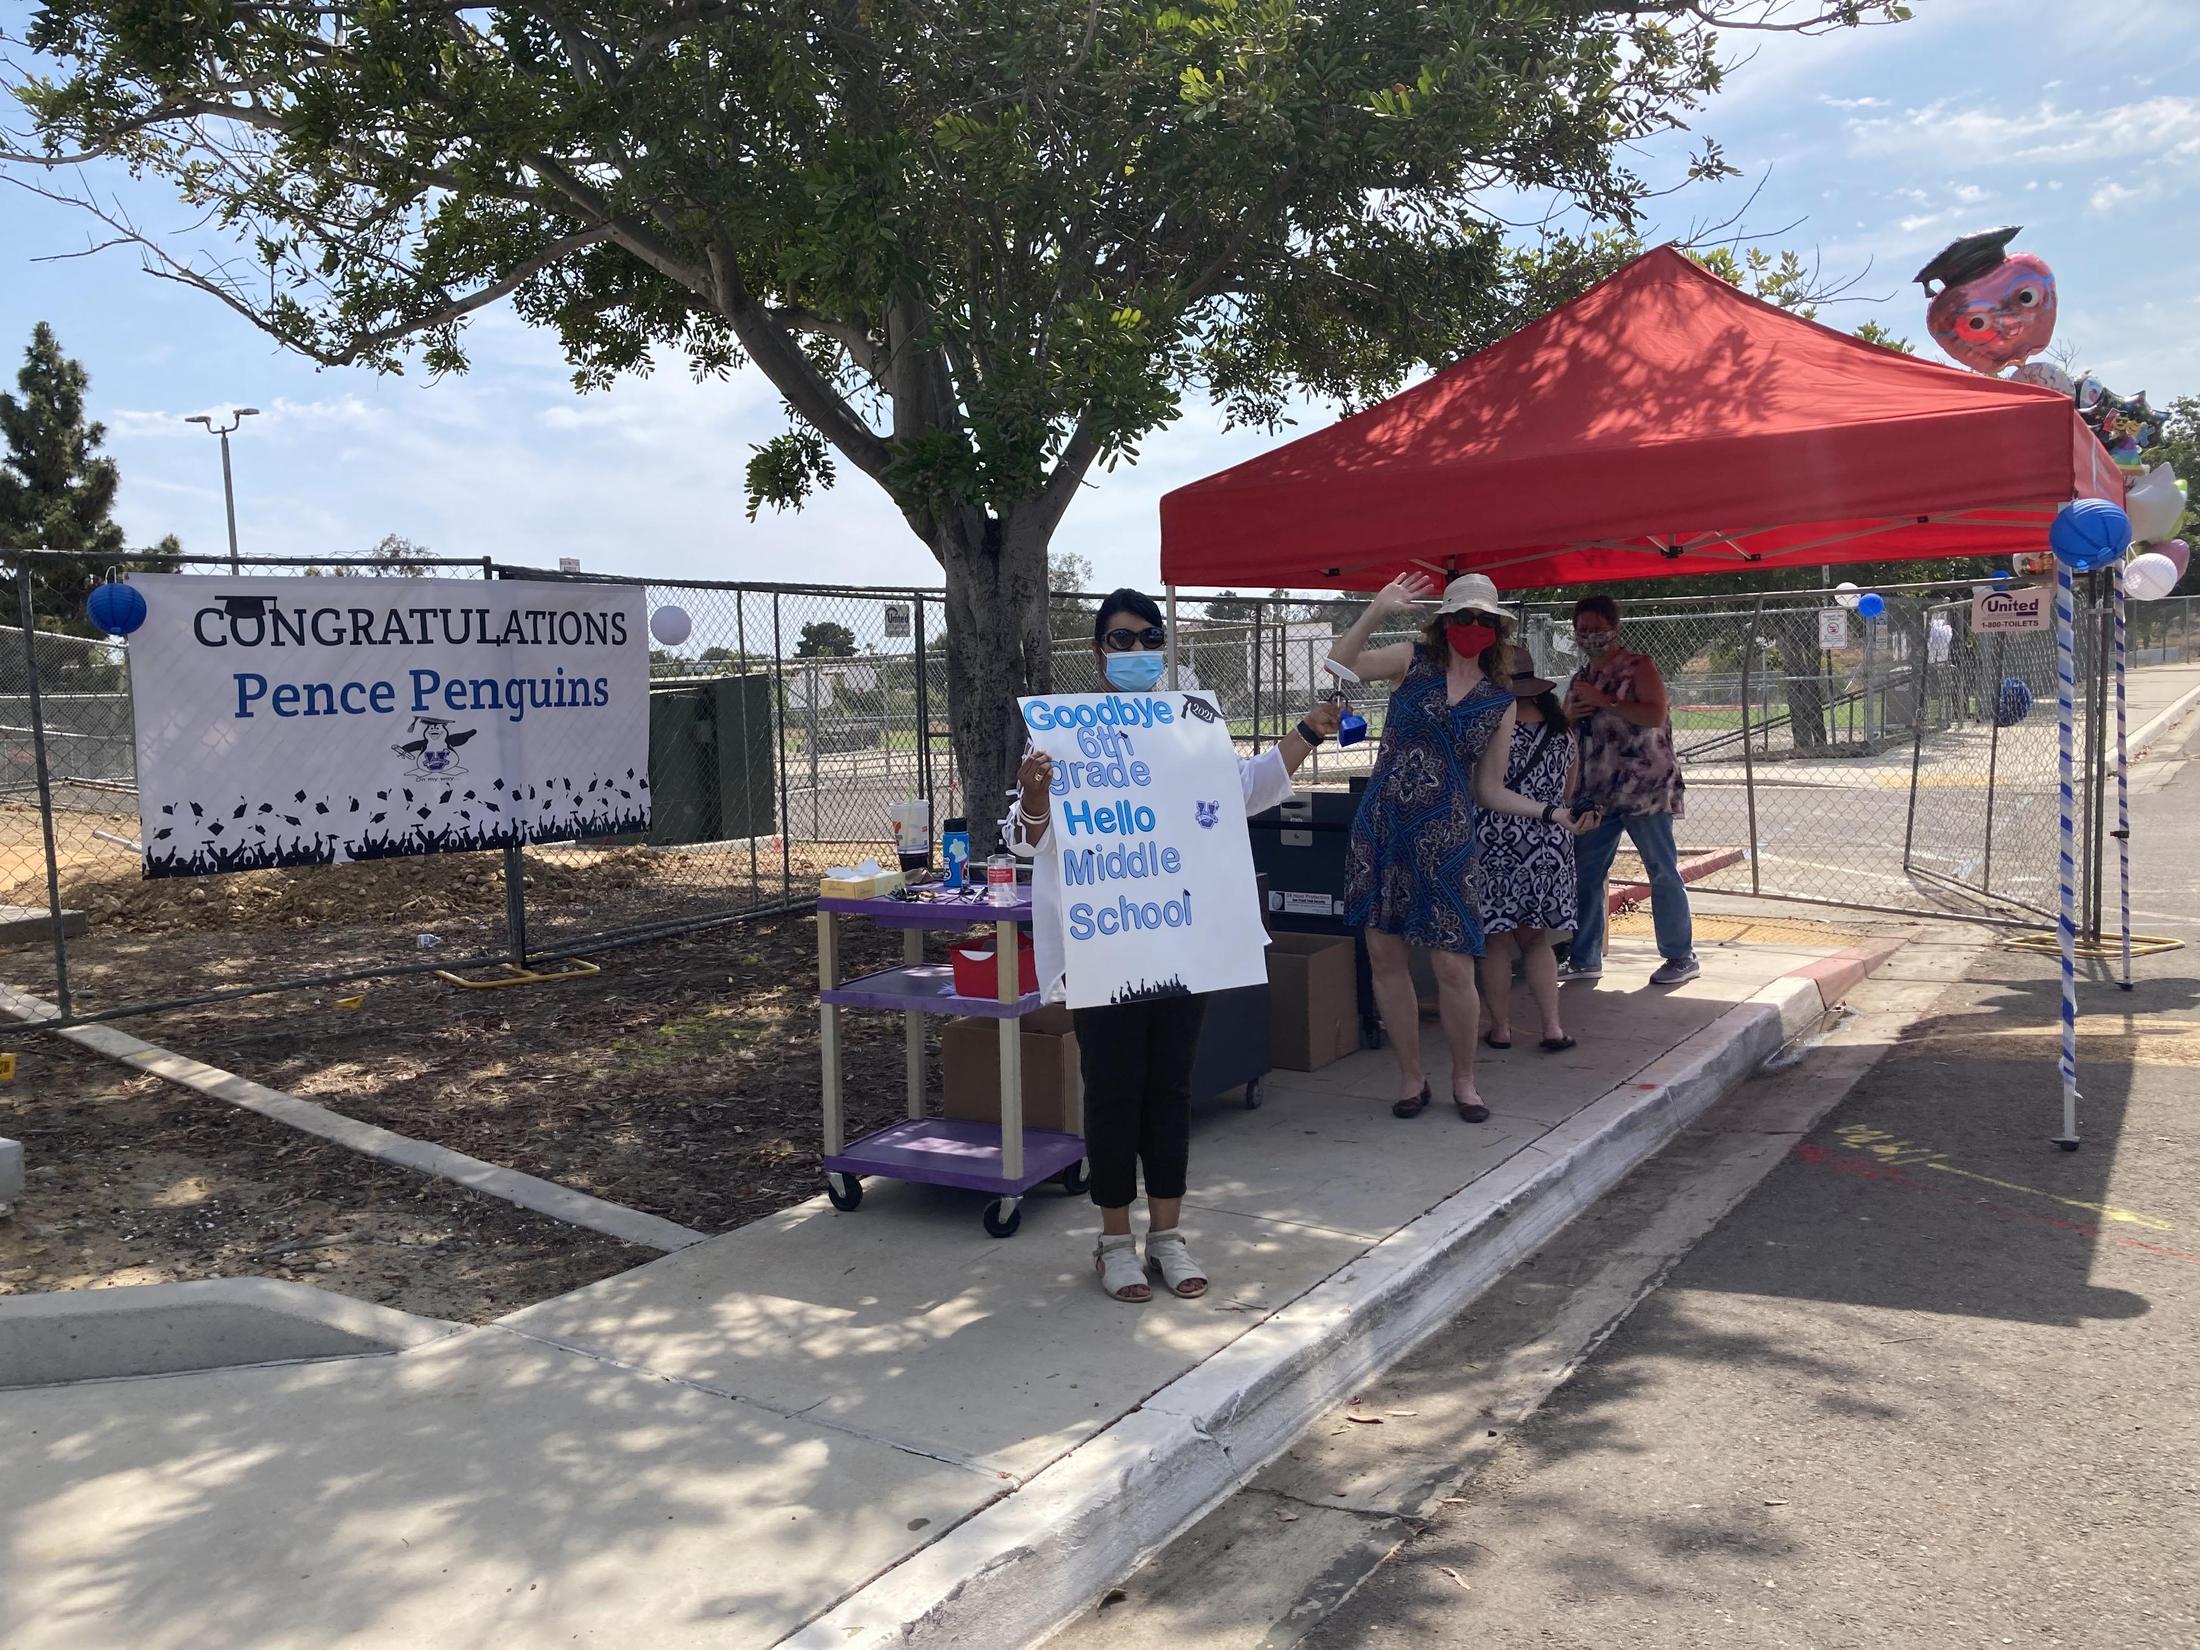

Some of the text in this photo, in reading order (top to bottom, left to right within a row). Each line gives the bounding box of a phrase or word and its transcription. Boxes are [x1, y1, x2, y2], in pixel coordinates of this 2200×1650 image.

[1988, 598, 2039, 612] United
[193, 607, 628, 648] CONGRATULATIONS
[233, 666, 609, 722] Pence Penguins
[1022, 695, 1175, 730] Goodbye
[1192, 703, 1214, 721] 2021
[1076, 726, 1135, 759] 6th
[1050, 752, 1152, 796] grade
[1063, 799, 1156, 836] Hello
[1064, 841, 1182, 887] Middle
[1069, 892, 1193, 941] School
